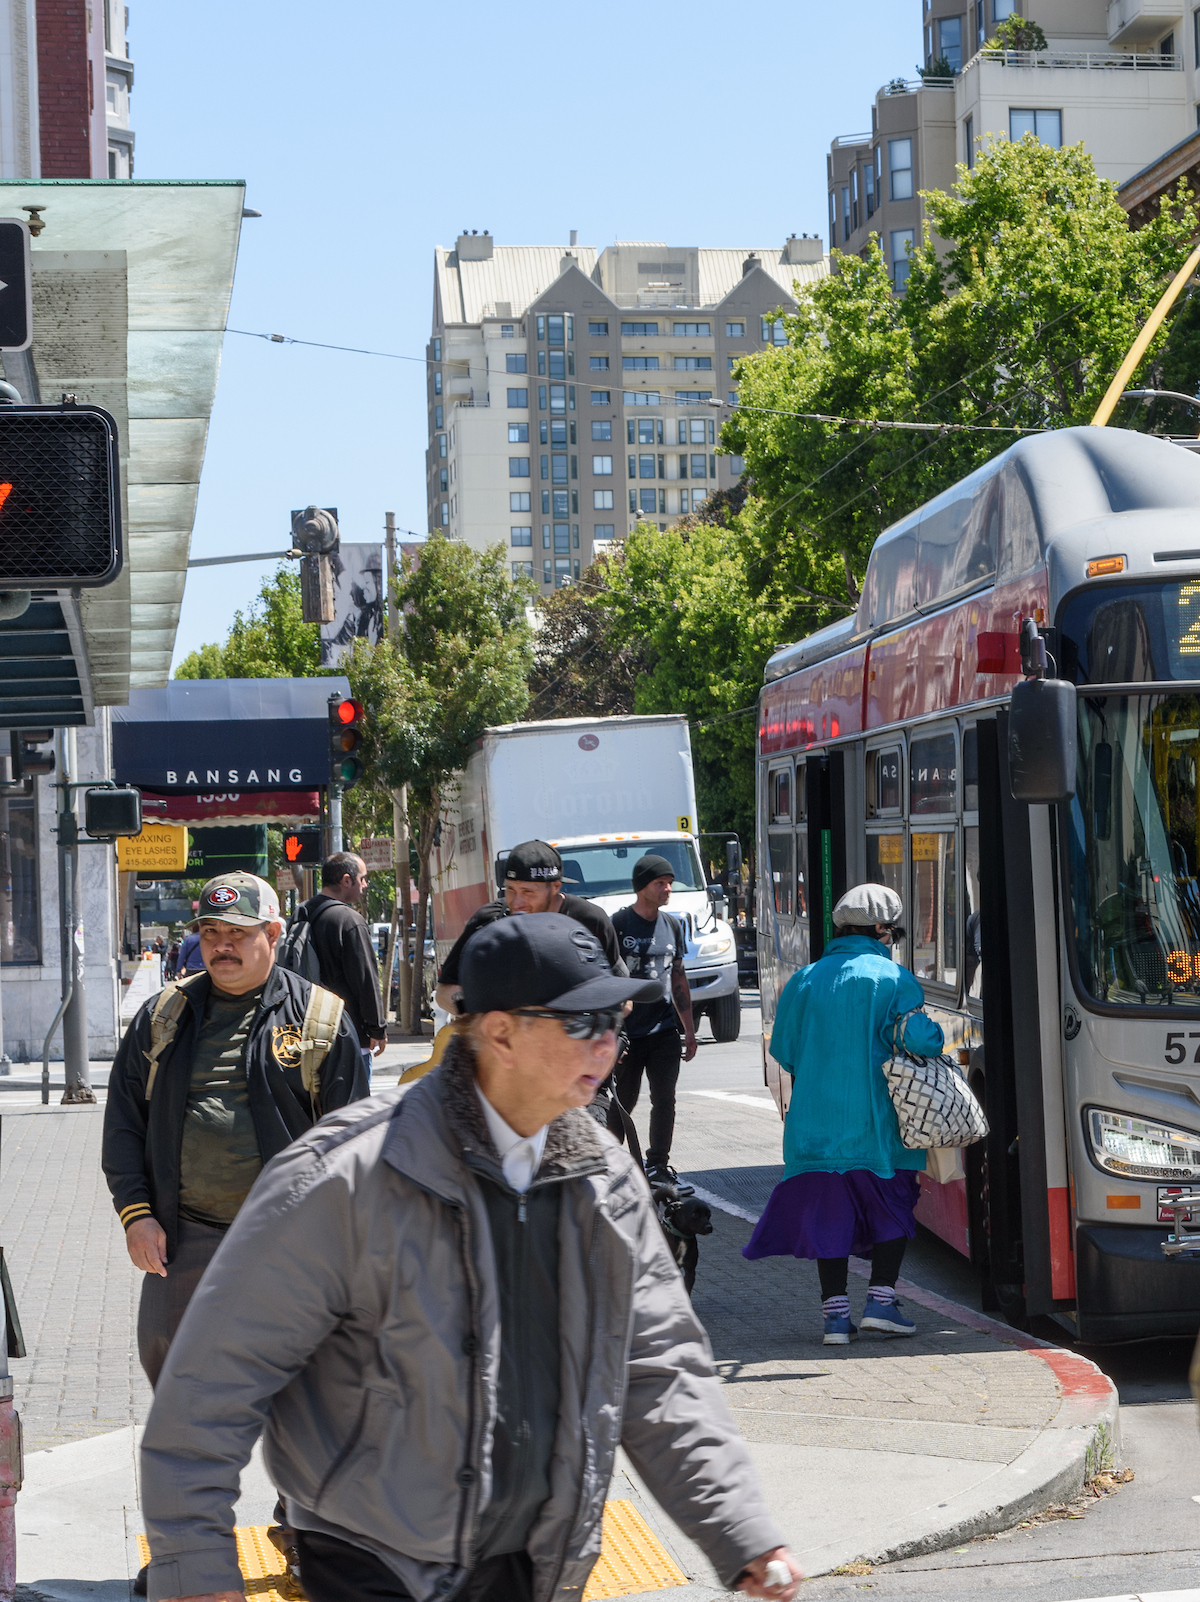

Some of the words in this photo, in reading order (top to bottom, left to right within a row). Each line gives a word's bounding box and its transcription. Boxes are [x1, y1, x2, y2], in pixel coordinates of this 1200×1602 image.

[166, 768, 303, 784] BANSANG
[130, 835, 172, 843] WAXING
[125, 846, 142, 855] EYE
[144, 846, 177, 855] LASHES
[187, 858, 204, 866] ORI
